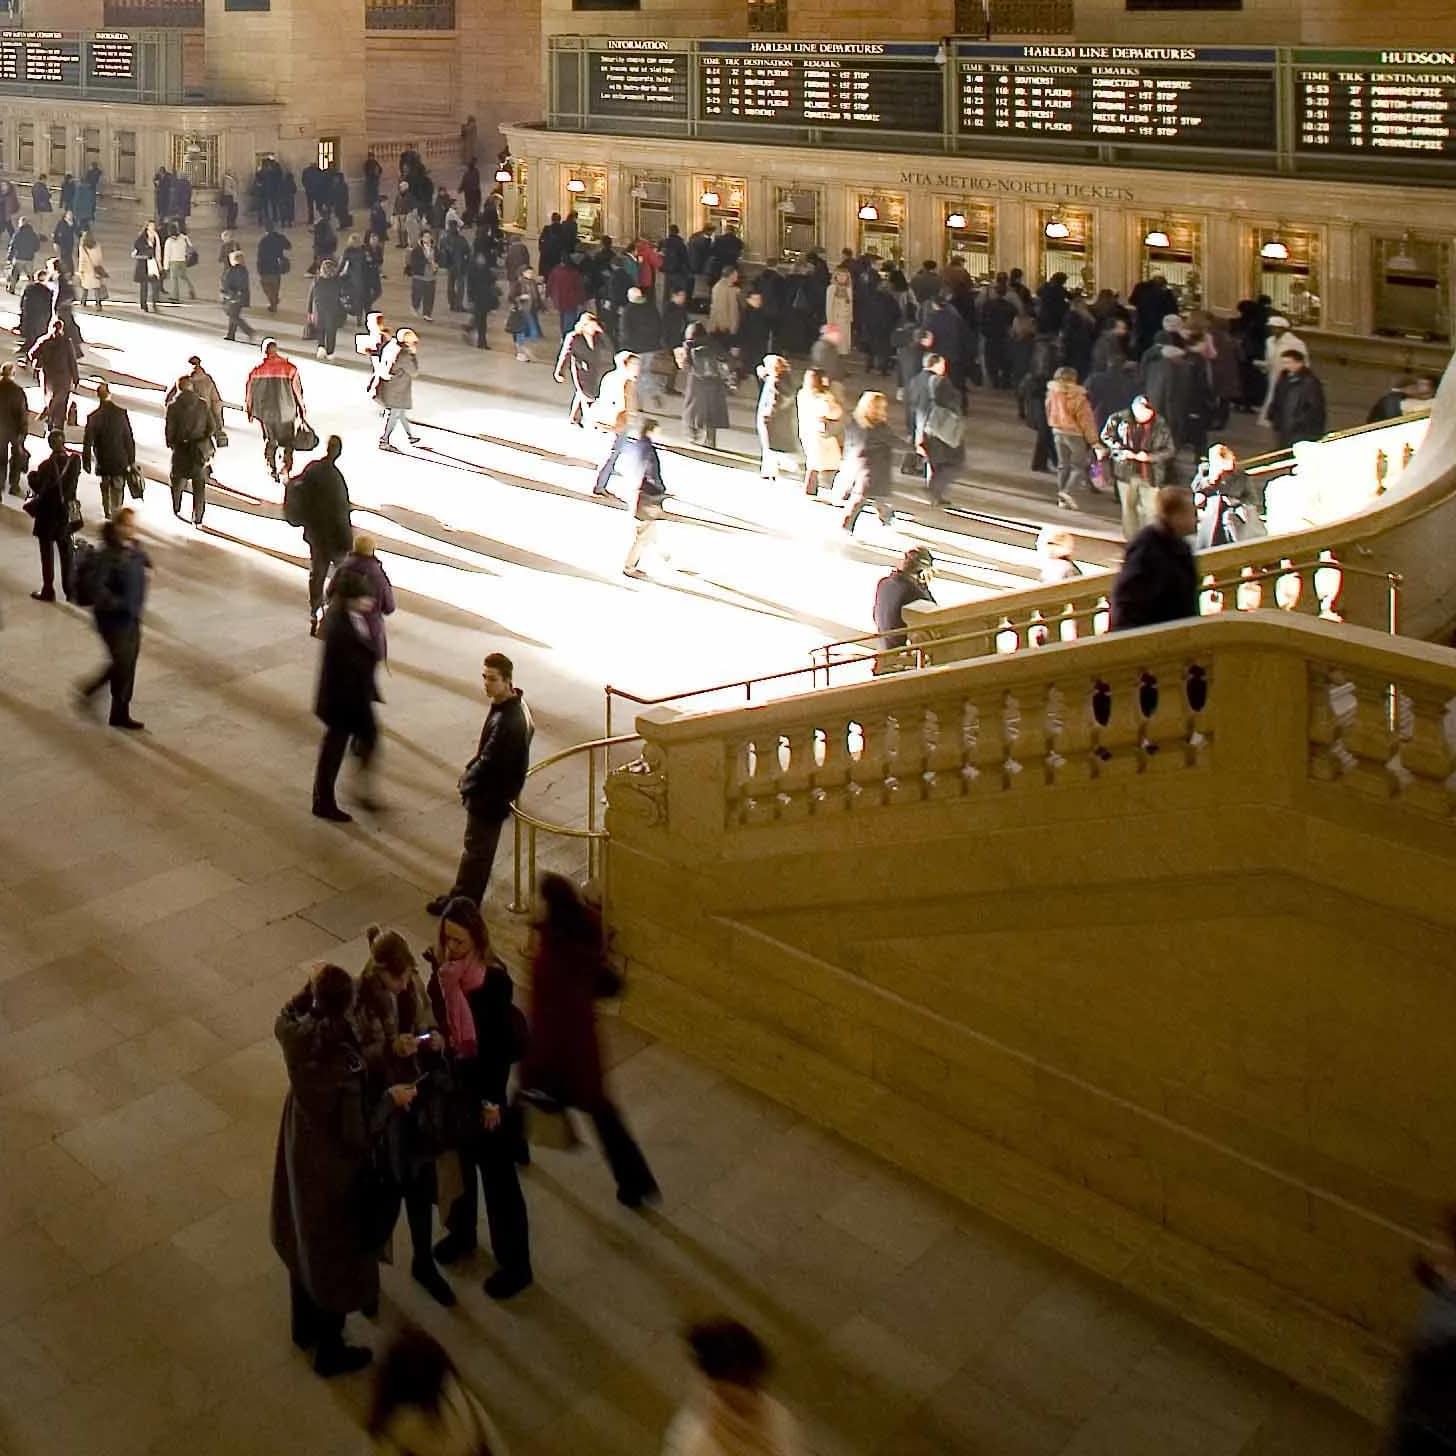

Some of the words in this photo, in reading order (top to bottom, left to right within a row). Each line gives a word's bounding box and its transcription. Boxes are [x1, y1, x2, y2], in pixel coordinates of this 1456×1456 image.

[608, 40, 669, 50] INFORMATION
[751, 42, 792, 52] HARLEM
[794, 43, 817, 52] LINE
[819, 44, 884, 54] DEPARTURES
[1024, 46, 1076, 57] HARLEM
[1079, 47, 1109, 58] LINE
[1112, 47, 1196, 59] DEPARTURES
[1381, 51, 1455, 64] HUDSON
[990, 64, 1009, 72] TRK
[1014, 65, 1078, 74] DESTINATION
[1091, 66, 1140, 75] REMARKS
[1301, 71, 1329, 80] TIME
[1337, 72, 1365, 81] TRK
[1371, 73, 1456, 83] DESTINATION
[1138, 91, 1153, 100] 1ST
[1156, 92, 1178, 101] STOP
[1138, 103, 1153, 112] 1ST
[1156, 104, 1178, 113] STOP
[1162, 116, 1177, 125] 1ST
[1180, 117, 1202, 126] STOP
[1156, 127, 1178, 136] STOP
[900, 171, 933, 186] MTA
[936, 174, 1057, 196] METRO-NORTH
[1062, 183, 1135, 201] TICKETS
